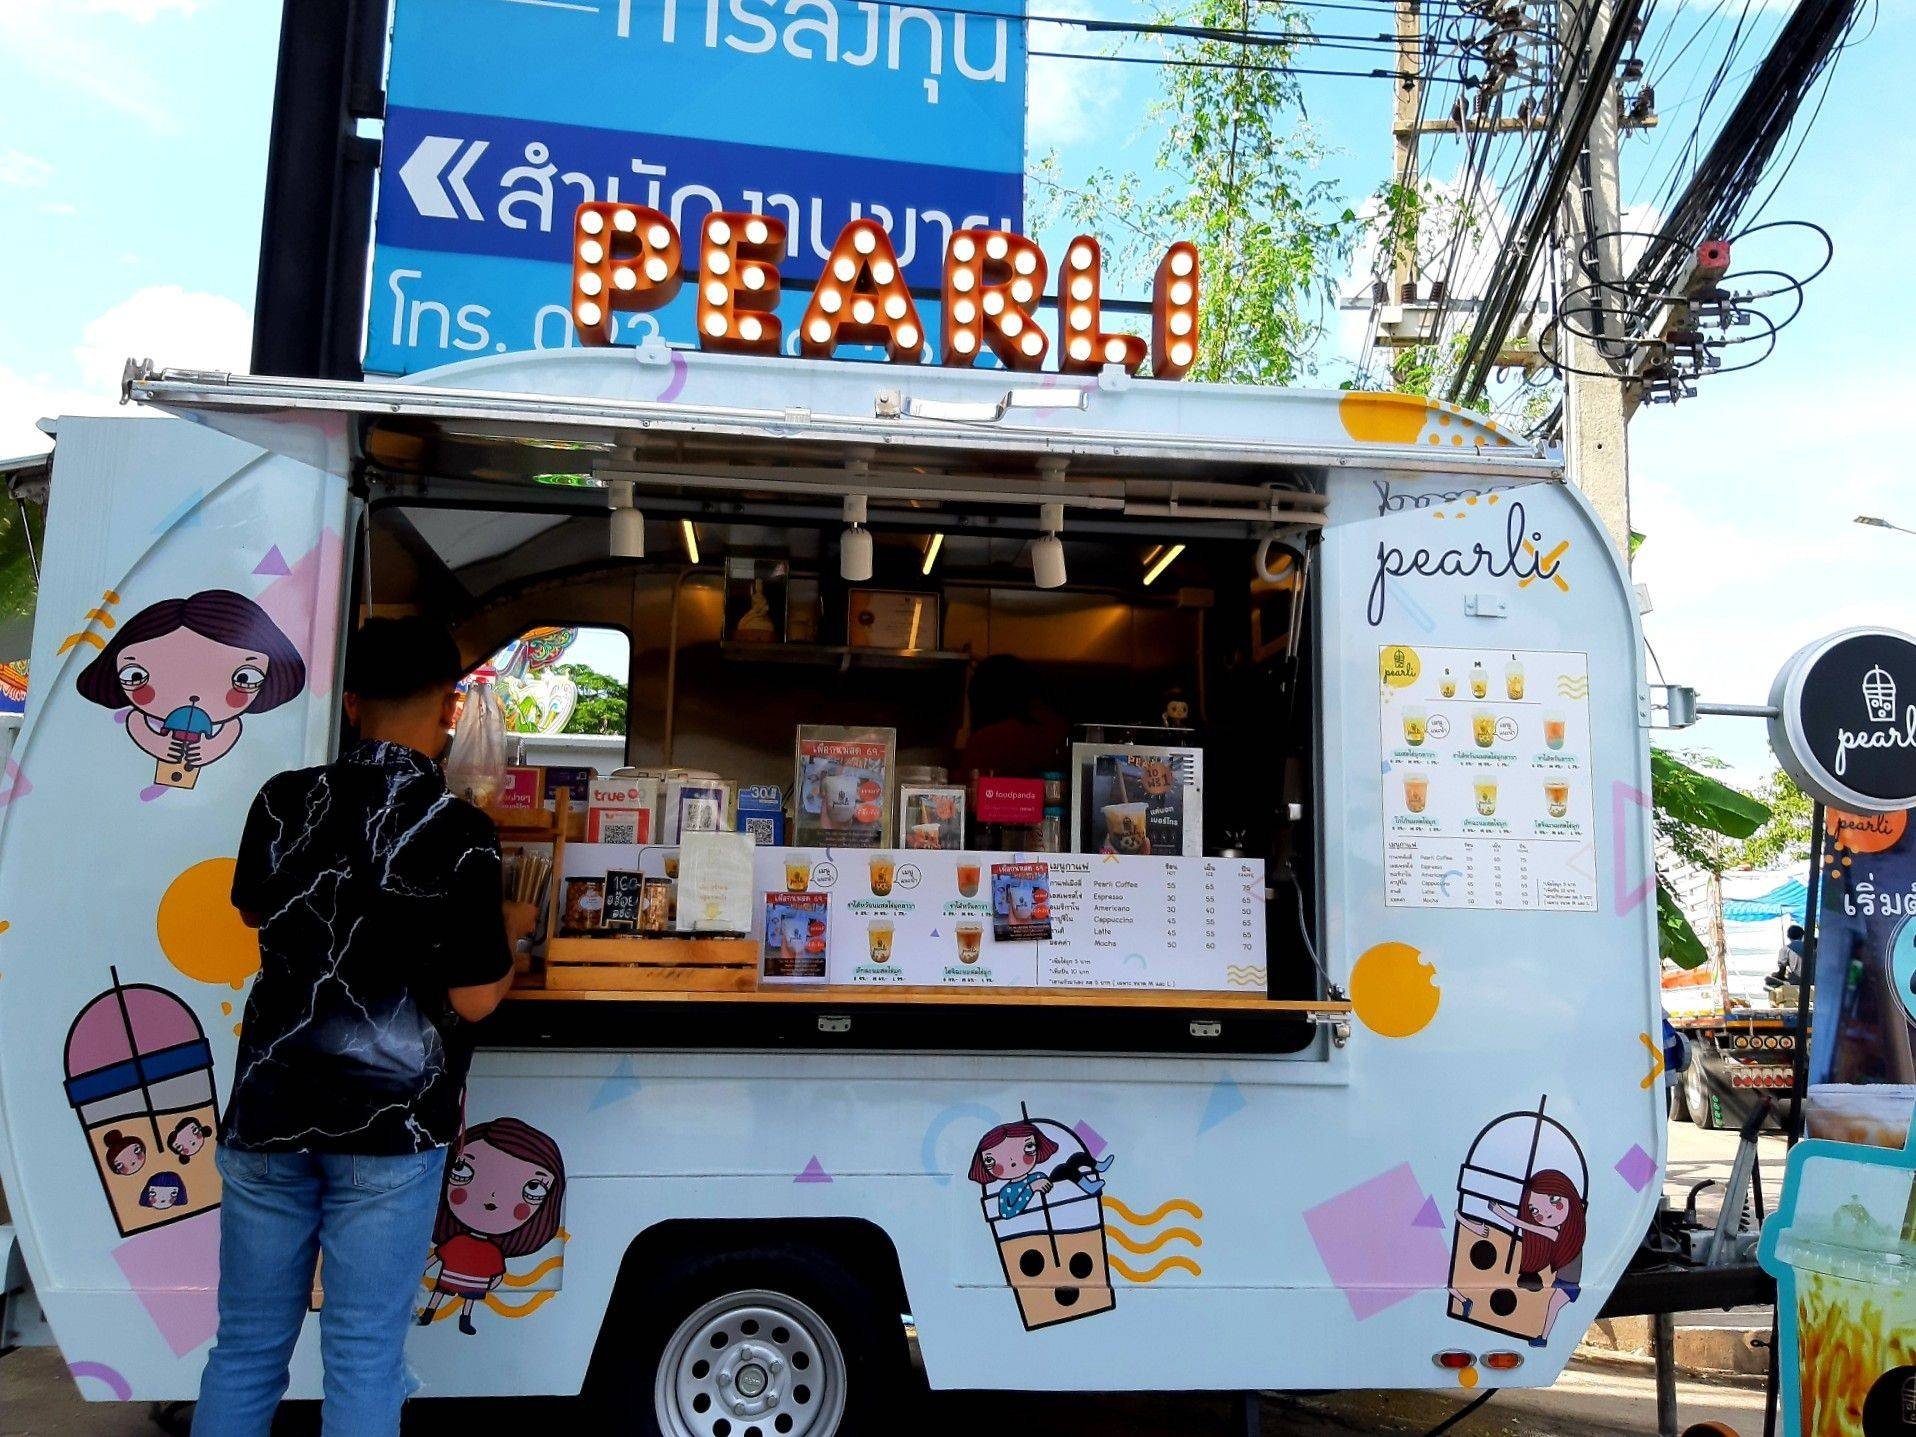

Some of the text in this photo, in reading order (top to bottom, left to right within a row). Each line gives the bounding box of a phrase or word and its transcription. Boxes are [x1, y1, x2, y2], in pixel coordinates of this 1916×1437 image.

[570, 200, 1200, 380] PEARLI
[389, 268, 507, 353] โทร.
[1367, 502, 1560, 626] pearli
[1383, 662, 1416, 684] pearli
[594, 790, 625, 802] true
[995, 790, 1036, 800] foodpanda
[1093, 893, 1124, 903] Espresso
[1093, 916, 1133, 925] Cappuccino
[1093, 927, 1112, 935] Latte
[1242, 943, 1252, 951] 70
